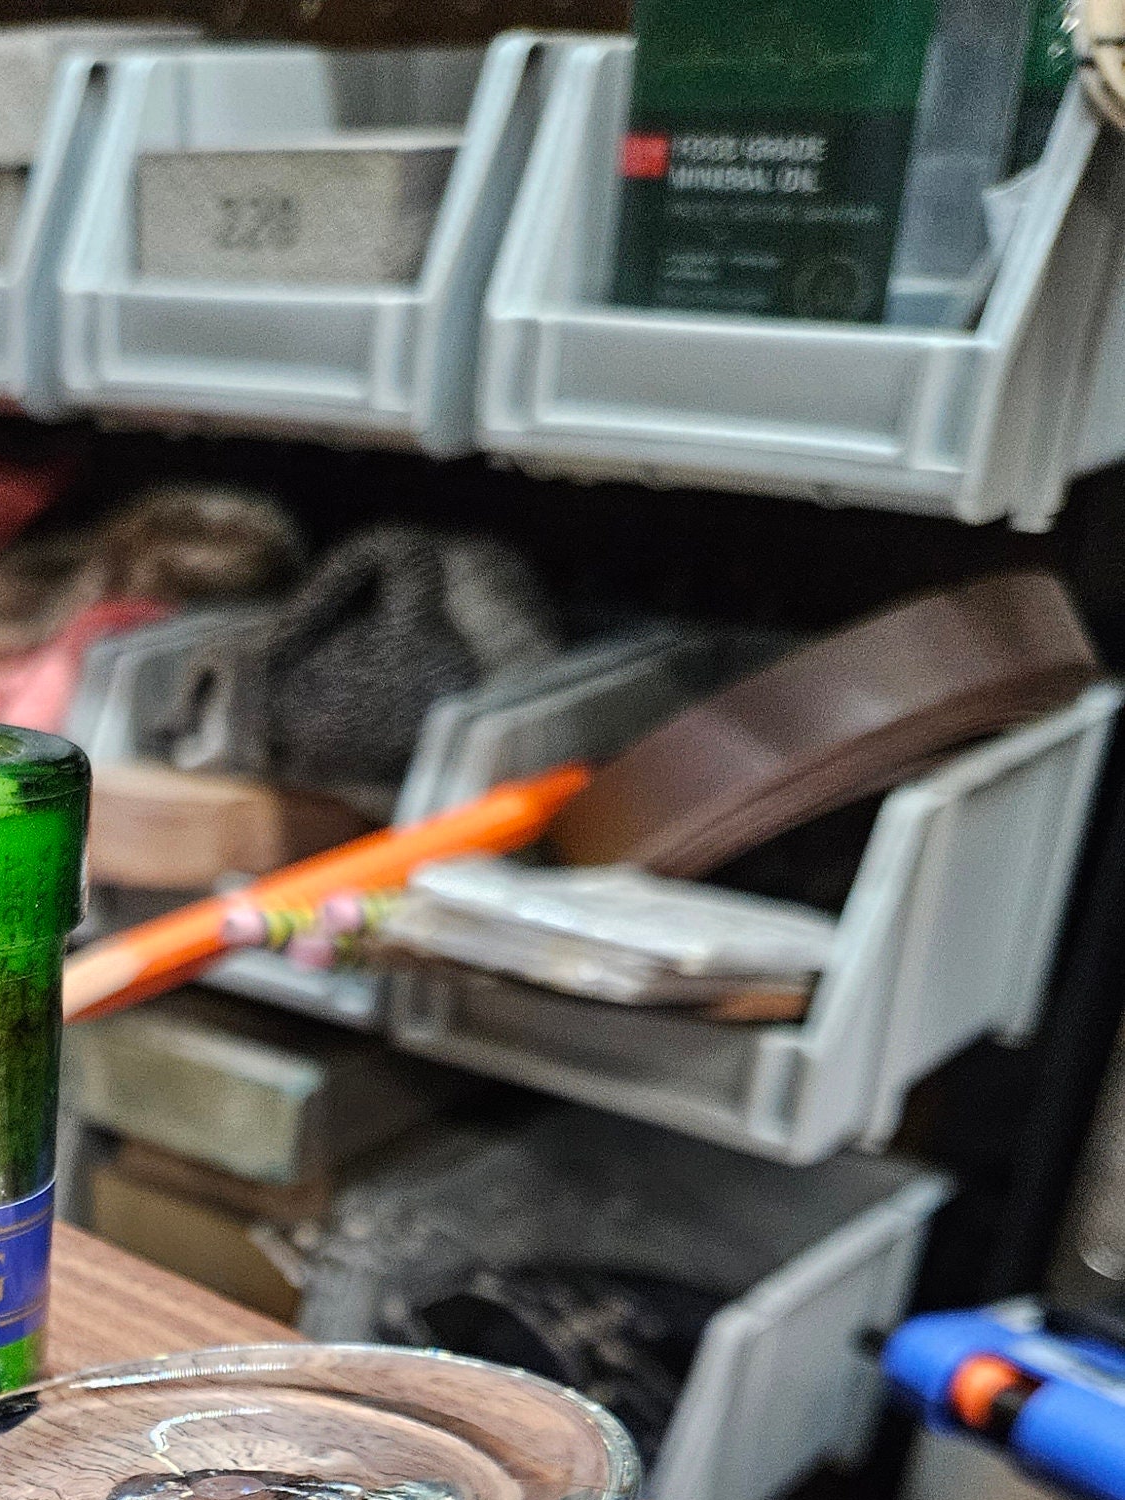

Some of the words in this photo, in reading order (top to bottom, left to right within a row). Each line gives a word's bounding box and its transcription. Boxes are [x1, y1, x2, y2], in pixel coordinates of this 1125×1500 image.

[673, 135, 738, 161] FOOD
[742, 135, 827, 162] GRADE
[669, 165, 773, 191] MINERAL
[776, 166, 822, 193] OIL
